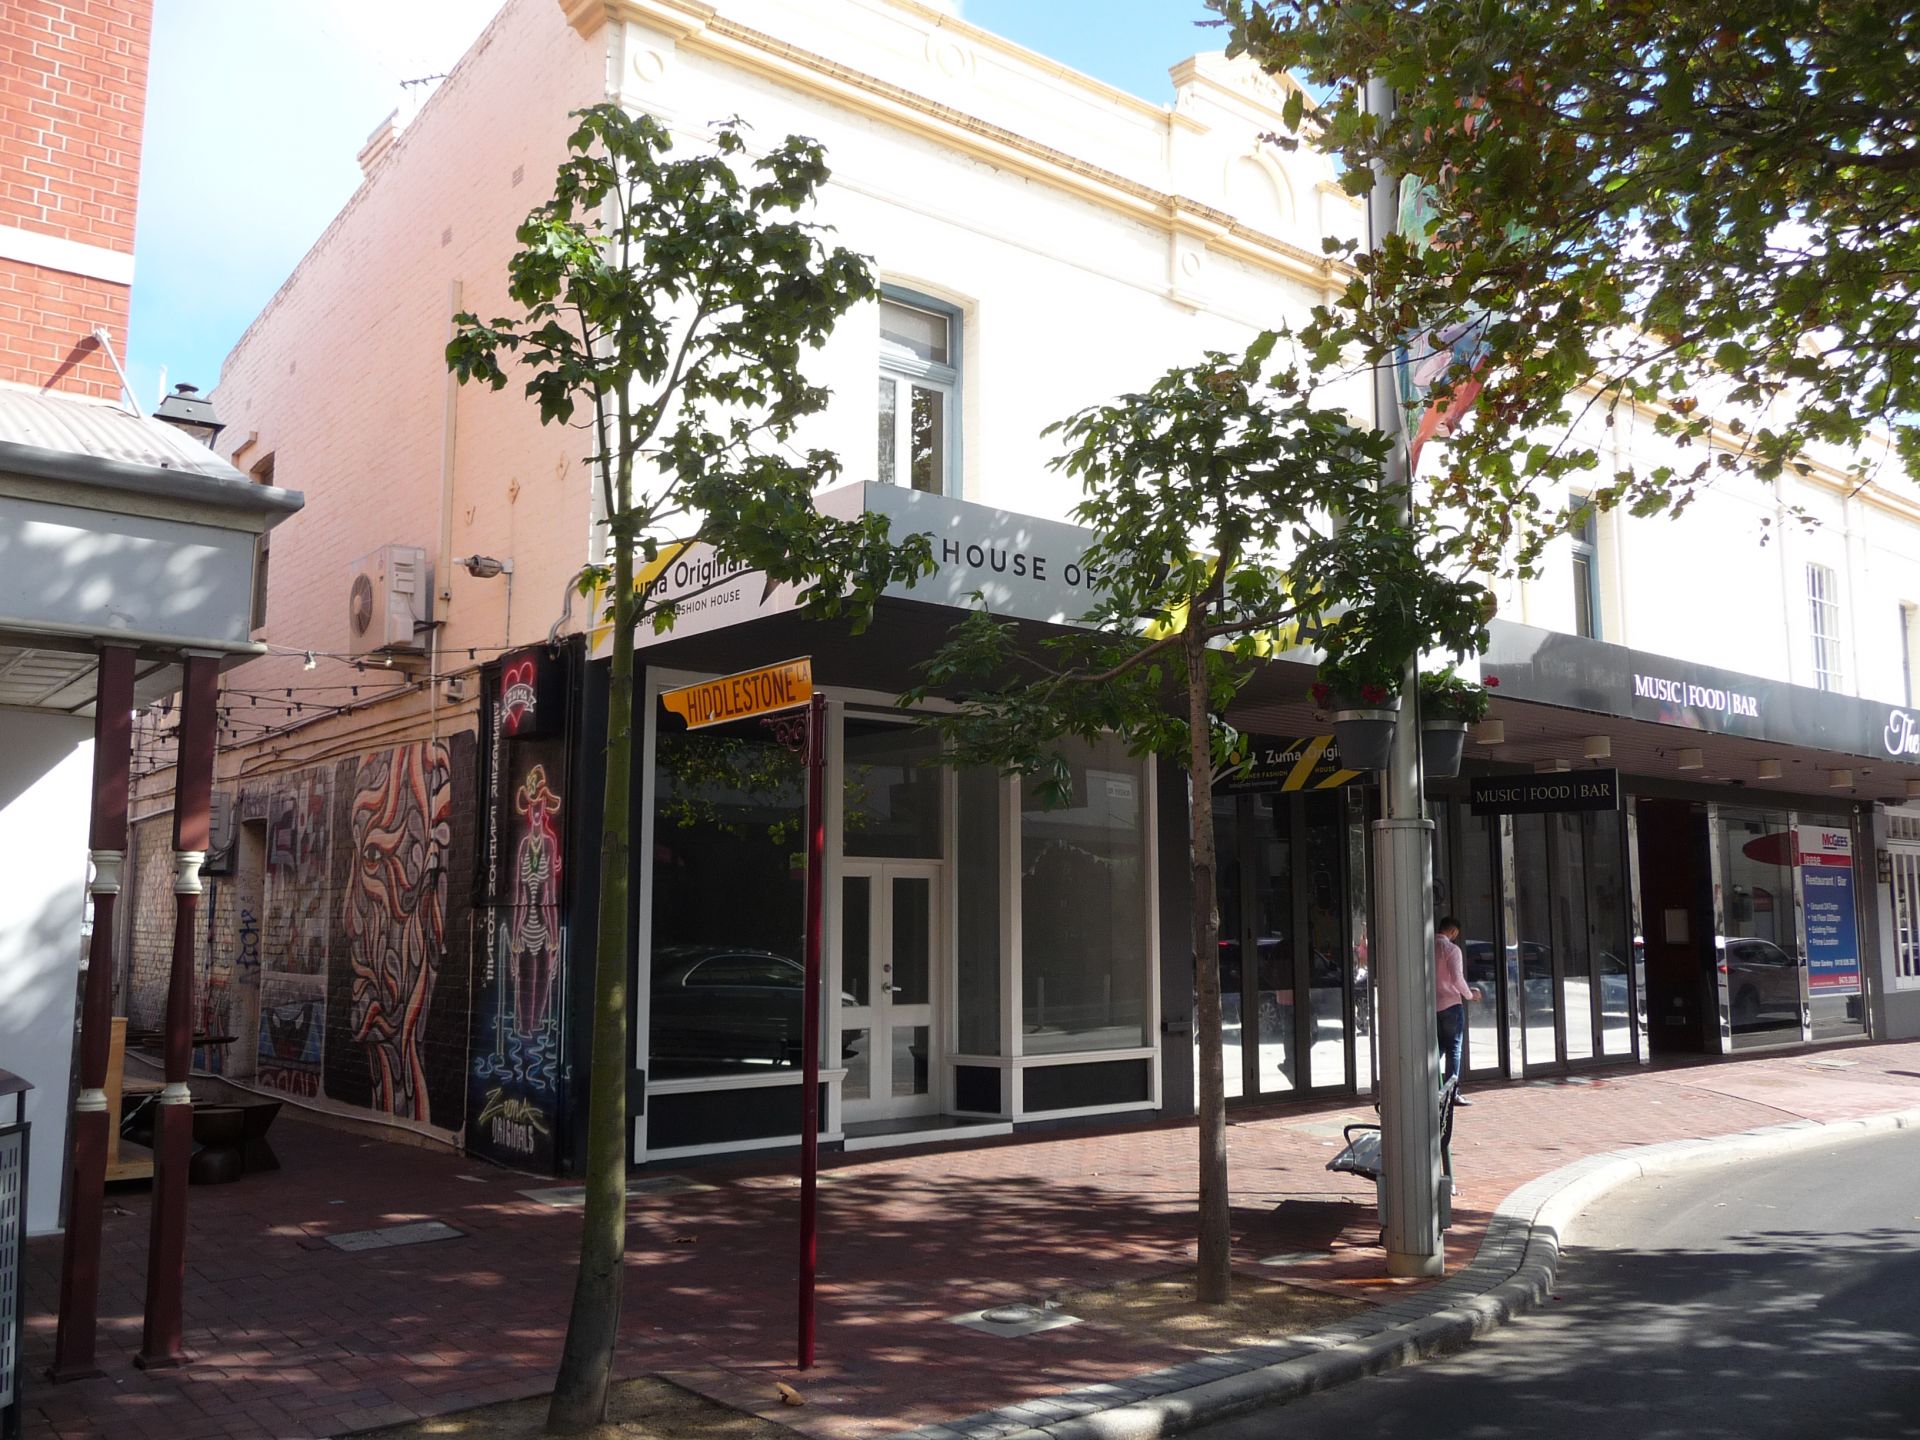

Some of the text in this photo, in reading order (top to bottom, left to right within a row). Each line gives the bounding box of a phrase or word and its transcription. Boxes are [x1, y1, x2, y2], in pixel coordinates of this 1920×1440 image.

[943, 538, 1099, 589] HOUSE OF
[710, 589, 741, 607] HOUSE
[686, 663, 808, 723] HIDDLESTONE LA
[1634, 674, 1758, 717] MUSIC FOOD BAR
[1266, 749, 1301, 764] Zuma
[1476, 783, 1610, 803] MUSIC FOOD BAR
